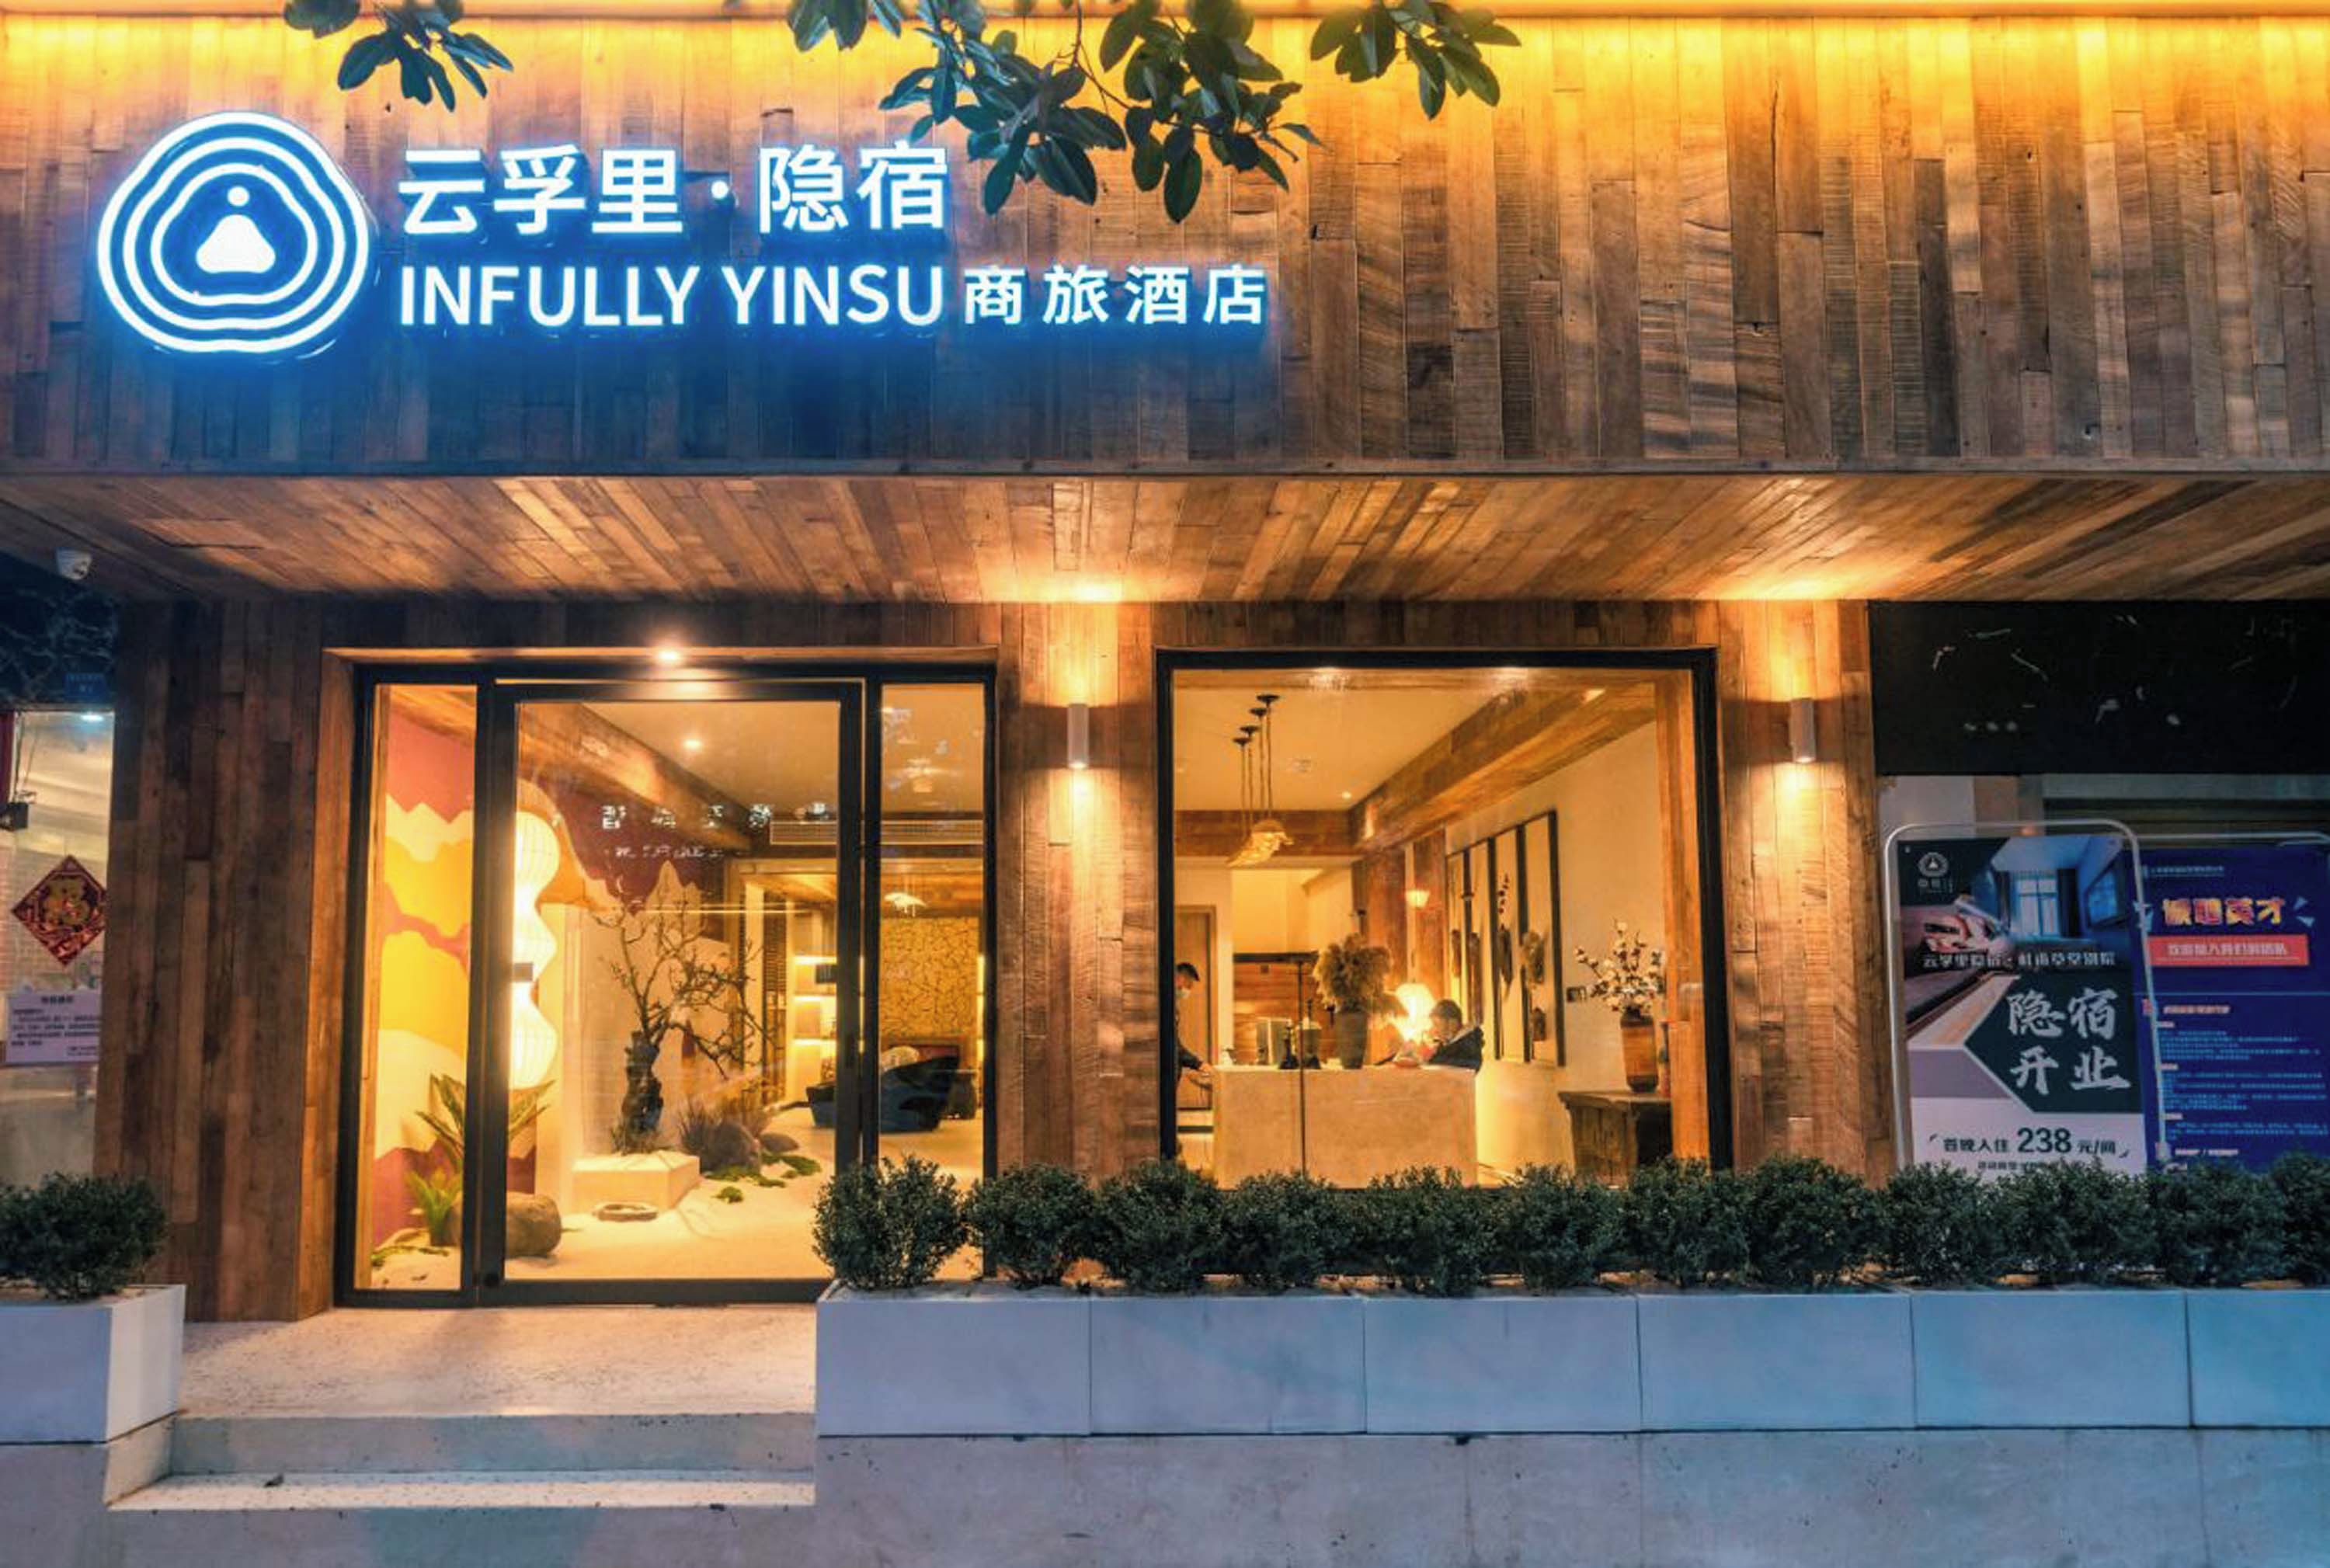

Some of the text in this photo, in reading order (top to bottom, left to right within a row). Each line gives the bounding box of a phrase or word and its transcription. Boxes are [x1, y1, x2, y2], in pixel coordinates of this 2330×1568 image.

[398, 142, 948, 235] 云孚里·隐宿
[401, 264, 1266, 326] INFULLY YINSU 商旅酒店
[2006, 987, 2119, 1040] 隐宿
[2009, 1045, 2132, 1096] 开业
[2017, 1128, 2072, 1153] 238
